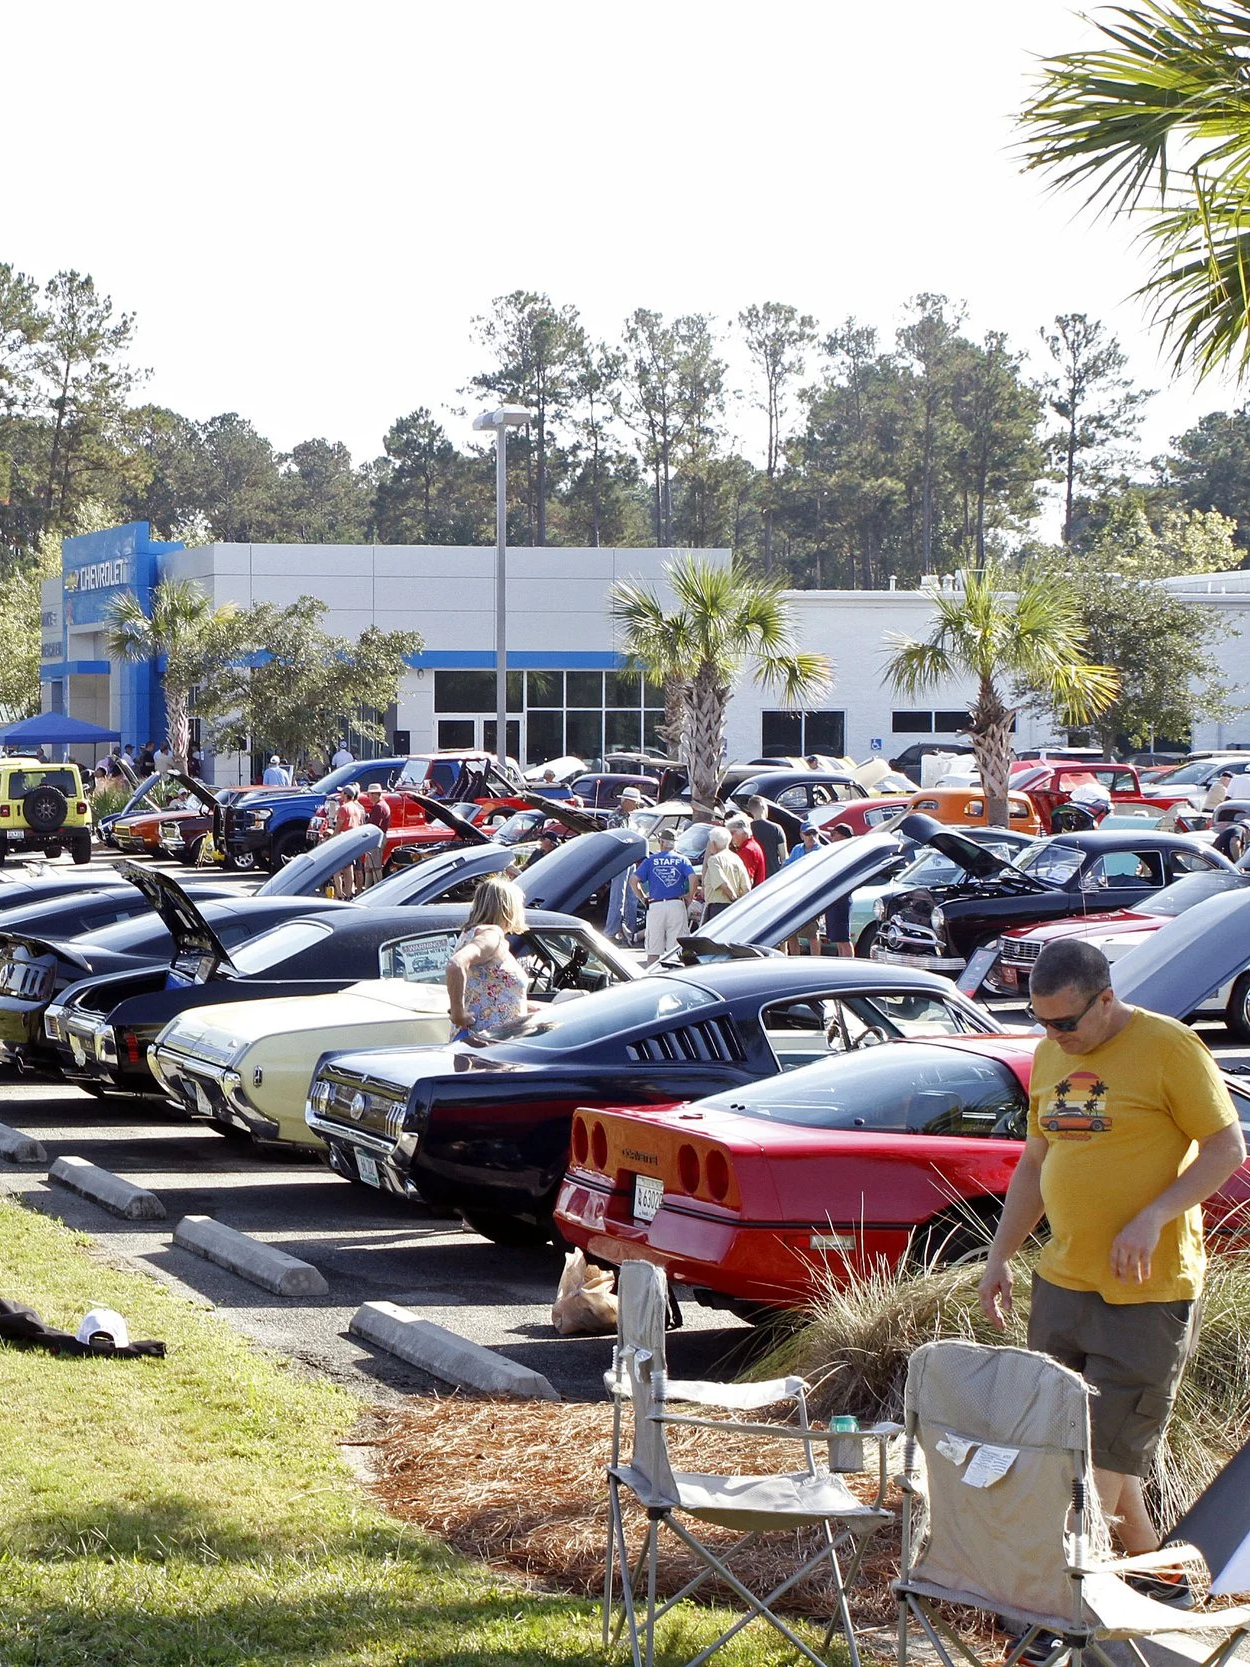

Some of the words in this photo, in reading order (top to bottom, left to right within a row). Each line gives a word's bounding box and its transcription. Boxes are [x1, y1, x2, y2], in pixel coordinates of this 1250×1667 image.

[80, 559, 124, 591] CHEVROLET
[653, 858, 680, 866] STAFF
[408, 940, 441, 951] WARNING
